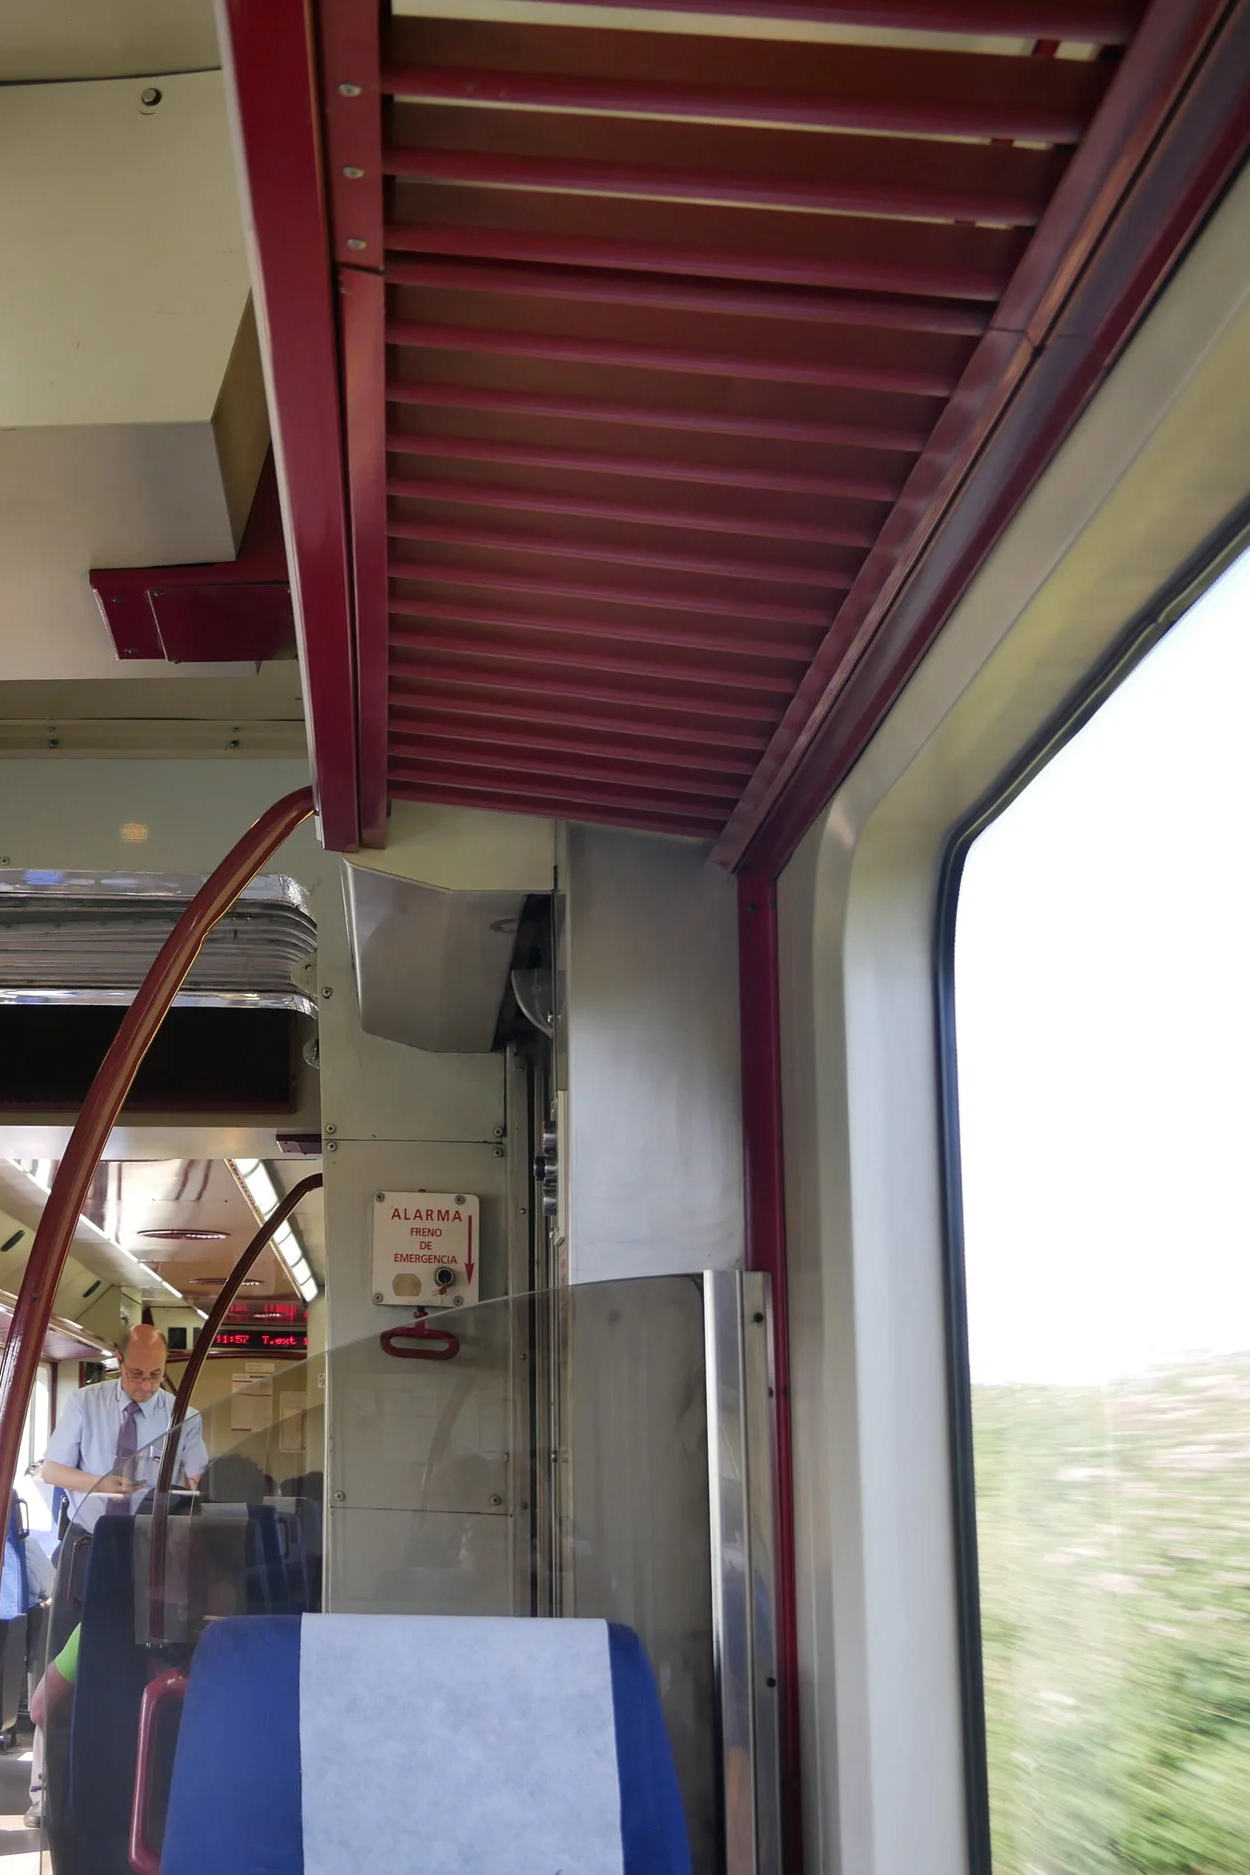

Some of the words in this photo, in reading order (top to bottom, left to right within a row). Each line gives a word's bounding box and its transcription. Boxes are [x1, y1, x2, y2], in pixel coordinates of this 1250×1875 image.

[391, 1207, 463, 1222] ALARMA
[410, 1227, 443, 1238] FRENO
[419, 1241, 432, 1250] DE
[394, 1253, 458, 1265] EMERGENCIA
[216, 1334, 250, 1344] 11:57
[262, 1335, 297, 1345] T.ext
